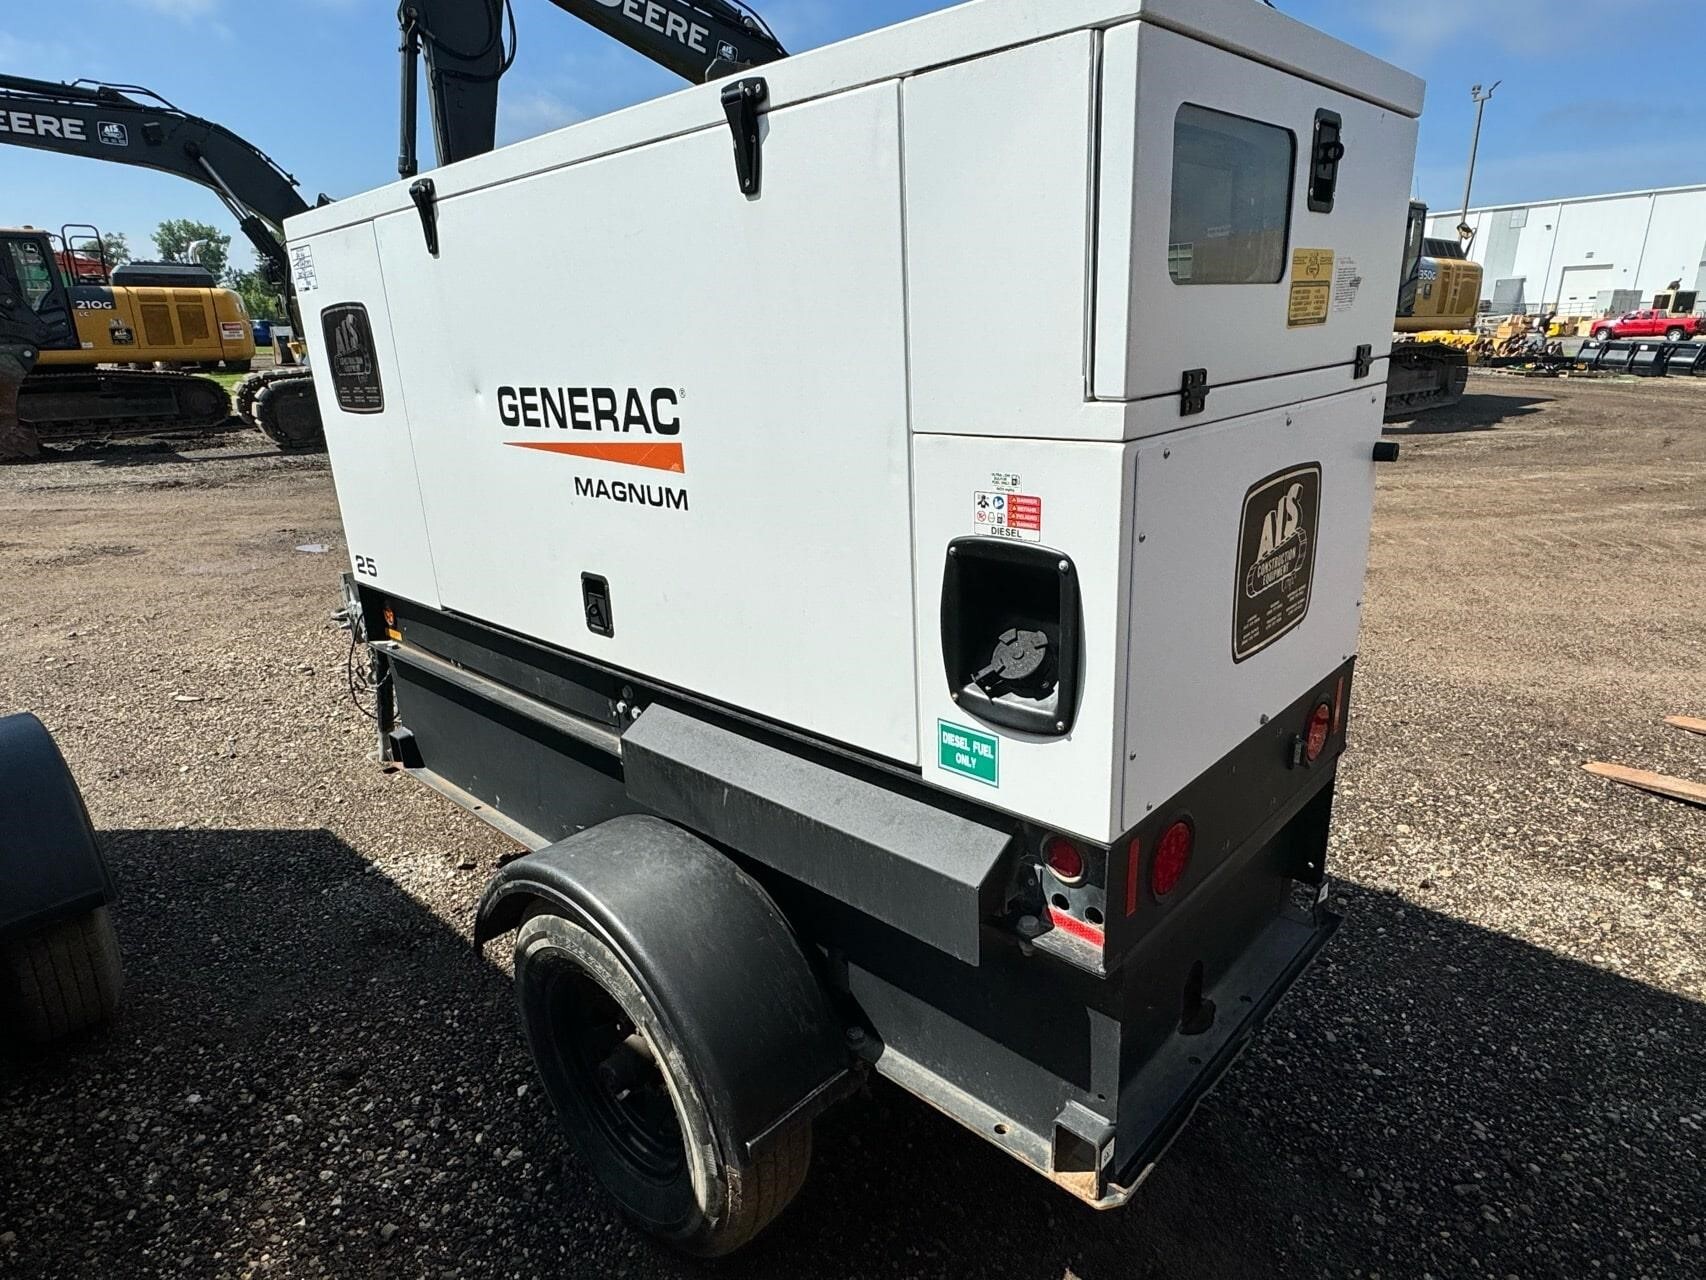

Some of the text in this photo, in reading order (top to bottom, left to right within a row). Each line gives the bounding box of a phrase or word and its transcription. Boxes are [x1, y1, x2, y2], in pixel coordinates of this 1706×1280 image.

[595, 0, 709, 54] EERE
[75, 300, 113, 310] 210G
[497, 383, 680, 436] GENERAC
[574, 476, 689, 511] MAGNUM
[991, 526, 1022, 538] DIESEL
[355, 554, 378, 577] 25
[1257, 546, 1296, 578] CONSTRUCTION
[1262, 561, 1289, 585] EQUIPMENT
[942, 730, 995, 759] DIESEL FUEL
[955, 752, 977, 769] ONLY
